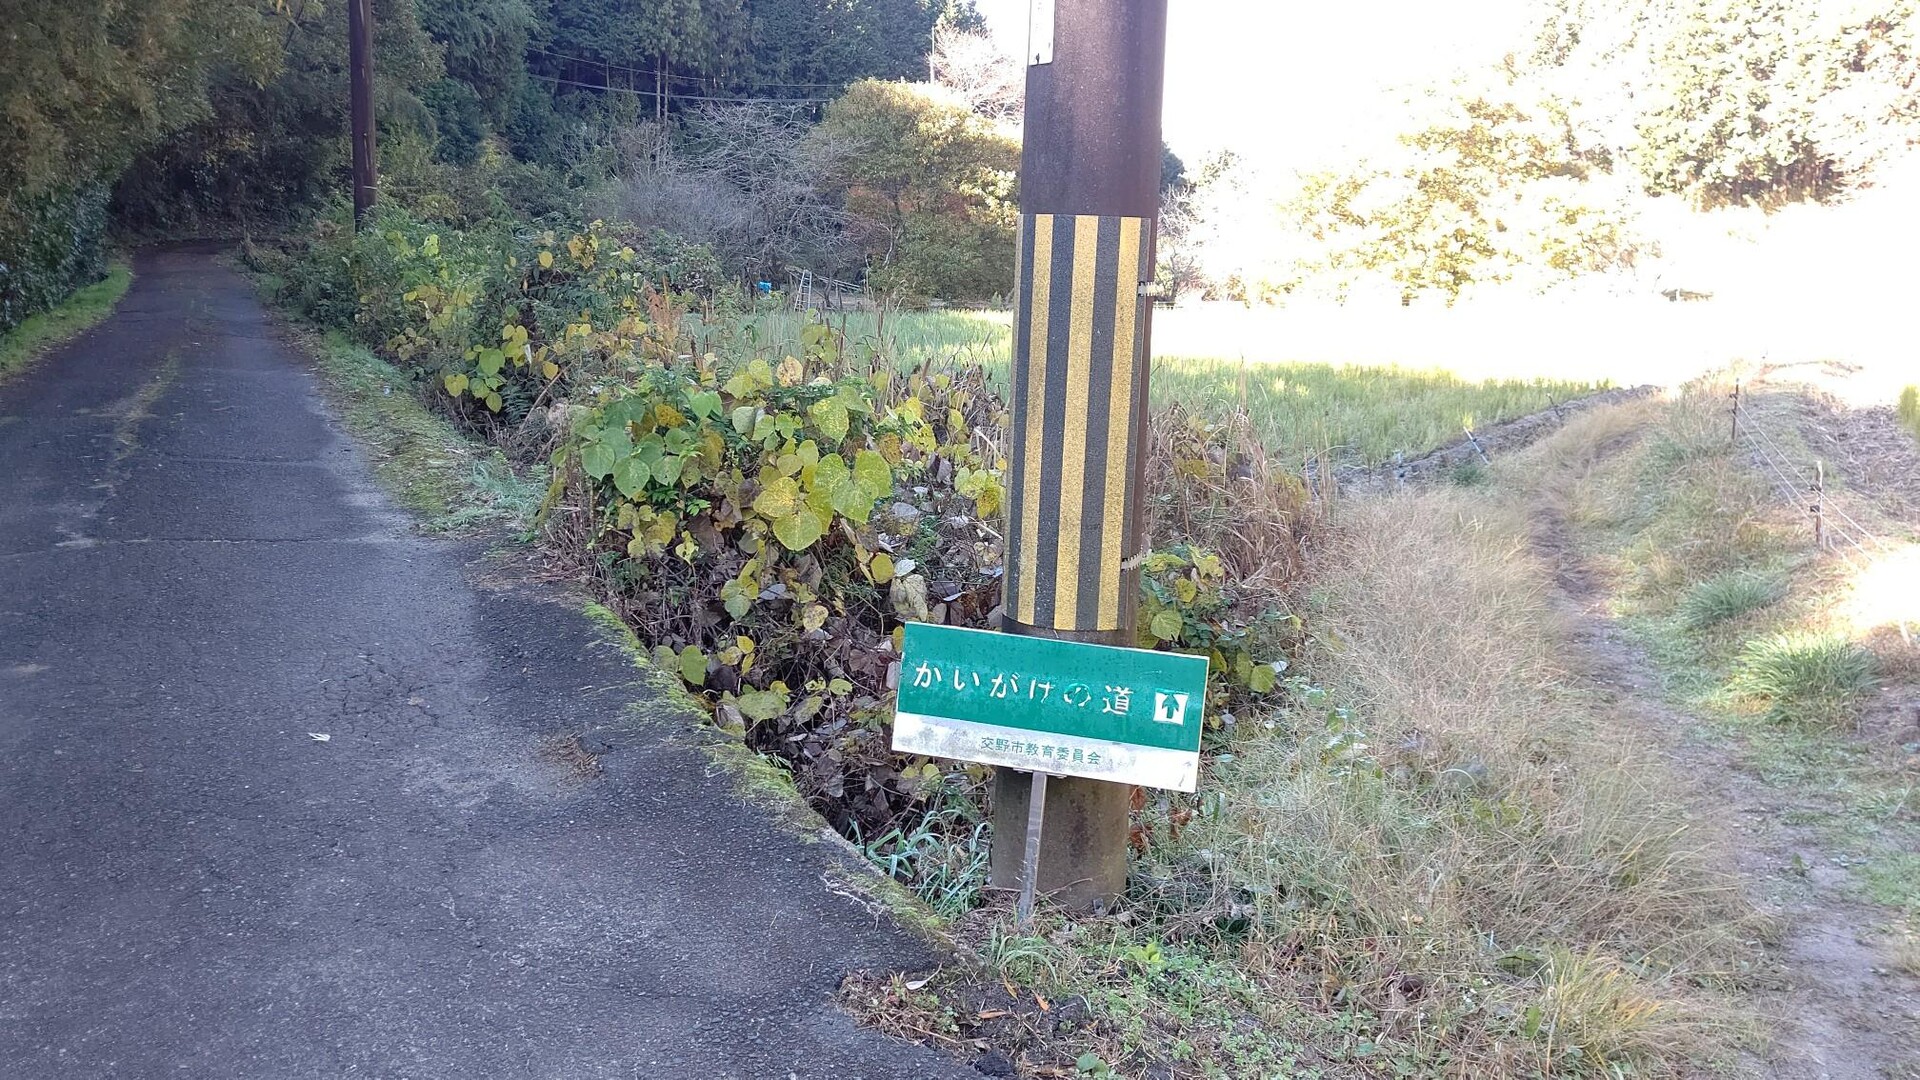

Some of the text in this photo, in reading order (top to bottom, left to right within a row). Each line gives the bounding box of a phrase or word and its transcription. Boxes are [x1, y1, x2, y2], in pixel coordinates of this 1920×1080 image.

[913, 662, 1133, 715] かいがけの道
[980, 736, 1101, 765] 交野市教育委員会
